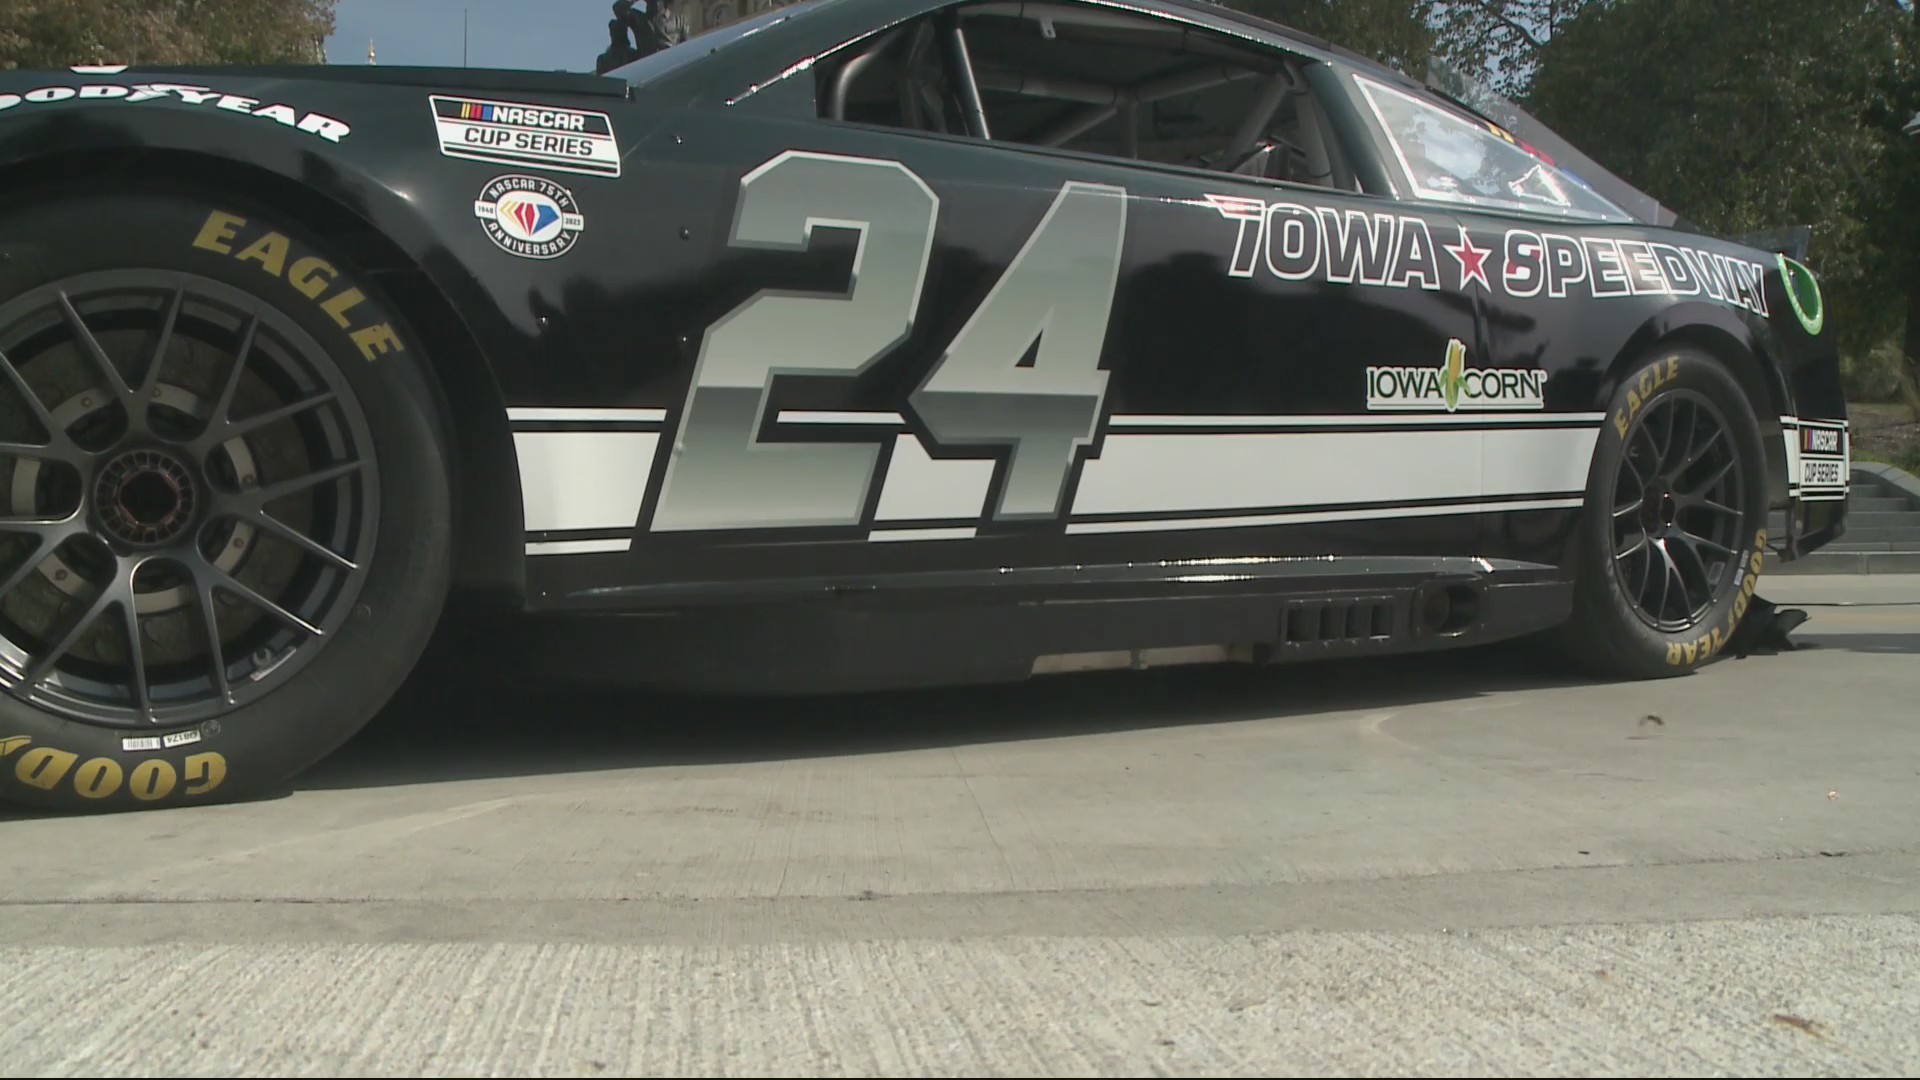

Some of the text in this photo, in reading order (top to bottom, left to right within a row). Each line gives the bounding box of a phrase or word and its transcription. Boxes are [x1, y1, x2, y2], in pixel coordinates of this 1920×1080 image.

[492, 106, 585, 131] NASCAR
[464, 127, 593, 156] CUP SERIES
[488, 178, 569, 207] NASCAR 75TH
[487, 221, 571, 255] ANNIVERSARY
[1203, 193, 1769, 318] IOWA SPEEDWAY
[192, 209, 404, 362] EAGLE
[650, 149, 1128, 532] 24
[1369, 370, 1443, 399] IOWA
[1613, 355, 1679, 440] EAGLE
[1812, 429, 1838, 451] NASCAR
[1805, 462, 1839, 482] CUP SERIES
